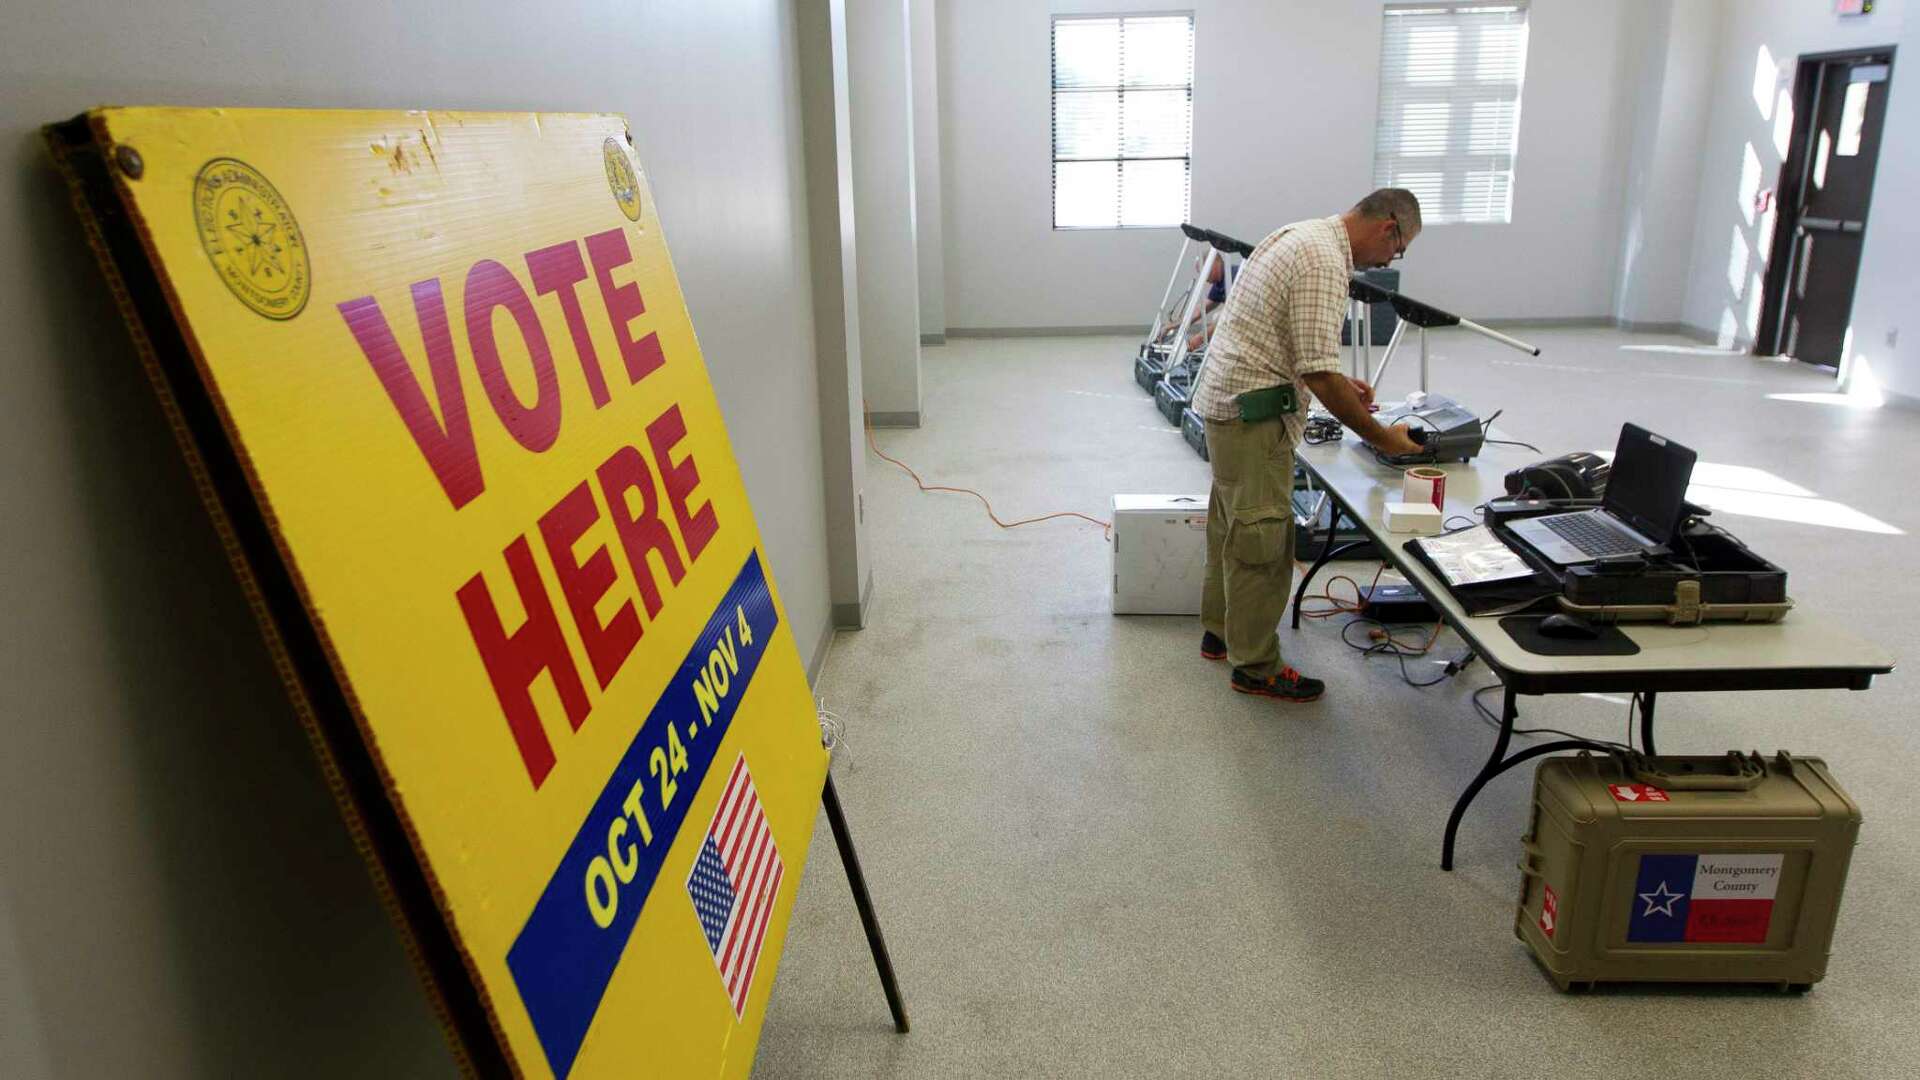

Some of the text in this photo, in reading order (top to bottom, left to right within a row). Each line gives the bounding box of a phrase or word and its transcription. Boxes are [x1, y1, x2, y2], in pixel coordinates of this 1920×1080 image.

[337, 228, 665, 511] VOTE
[455, 404, 720, 791] HERE
[585, 780, 652, 929] OCT
[650, 721, 688, 810] 24
[693, 627, 739, 725] NOV
[737, 604, 753, 645] 4
[1700, 864, 1778, 878] Montgomery
[1713, 880, 1760, 894] County
